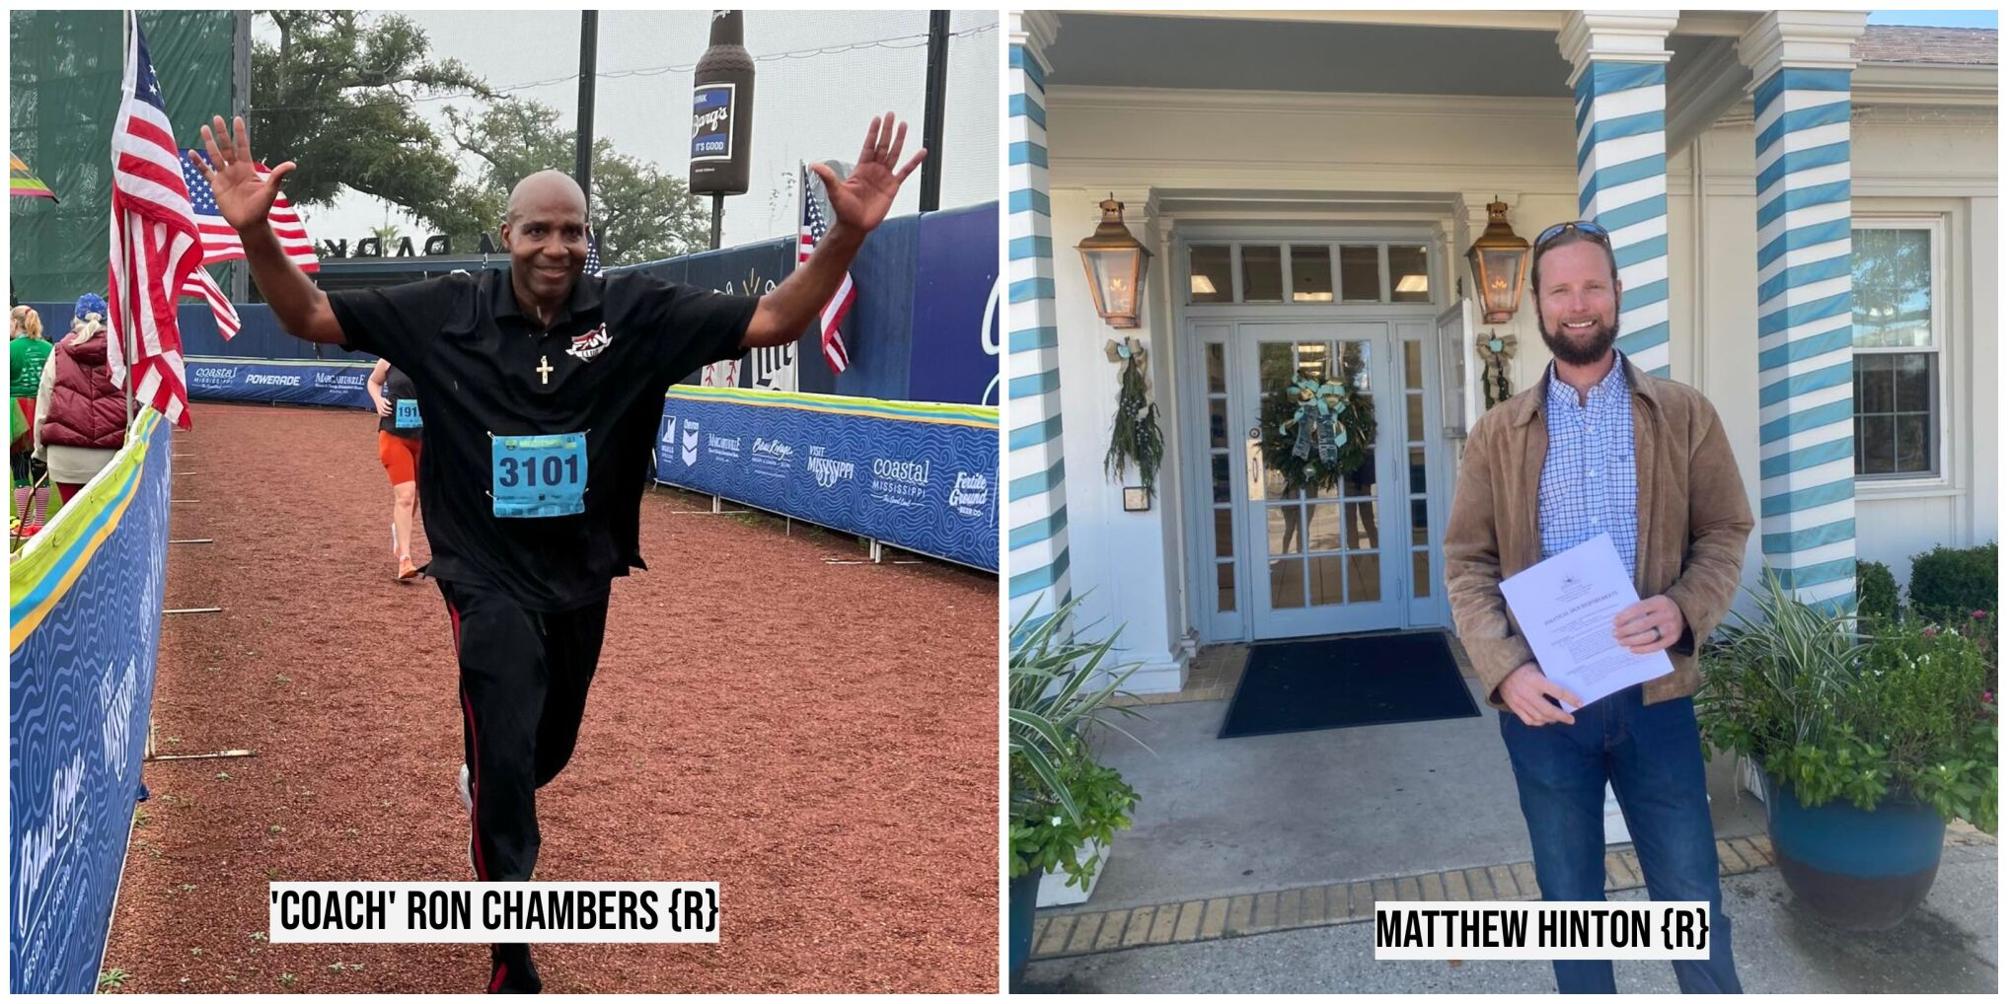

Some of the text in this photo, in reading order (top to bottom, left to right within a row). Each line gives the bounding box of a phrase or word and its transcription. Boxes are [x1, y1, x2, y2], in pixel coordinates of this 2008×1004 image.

[706, 141, 724, 151] GOOD
[245, 374, 301, 386] POWERADE
[810, 444, 826, 457] VISIT
[500, 454, 577, 487] 3101
[874, 458, 929, 484] coastal
[872, 479, 926, 498] MISSISSIPPI
[955, 471, 987, 490] Fertile
[949, 488, 988, 506] Ground
